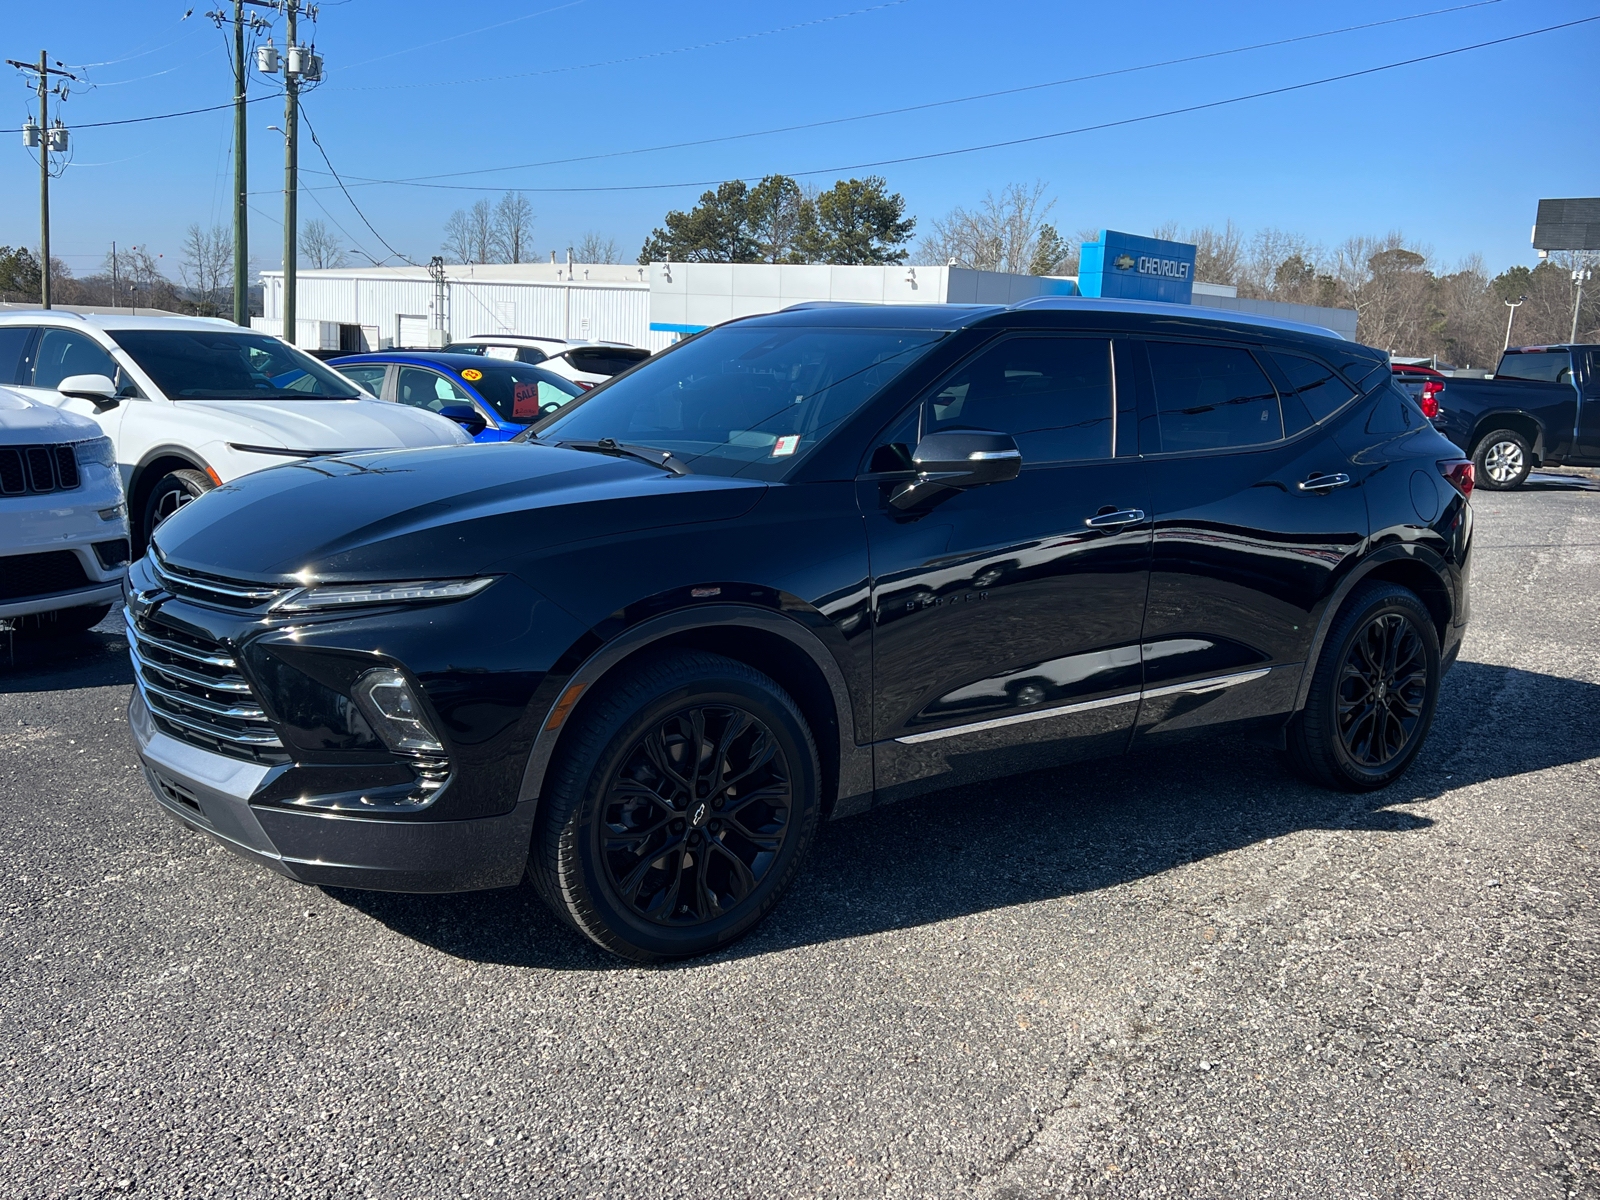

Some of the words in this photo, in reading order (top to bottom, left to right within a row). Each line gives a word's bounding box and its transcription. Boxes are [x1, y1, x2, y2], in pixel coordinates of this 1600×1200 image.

[1139, 256, 1190, 279] CHEVROLET
[516, 386, 537, 402] SALE
[906, 591, 988, 611] BLAZER
[762, 835, 806, 910] MICHELIN
